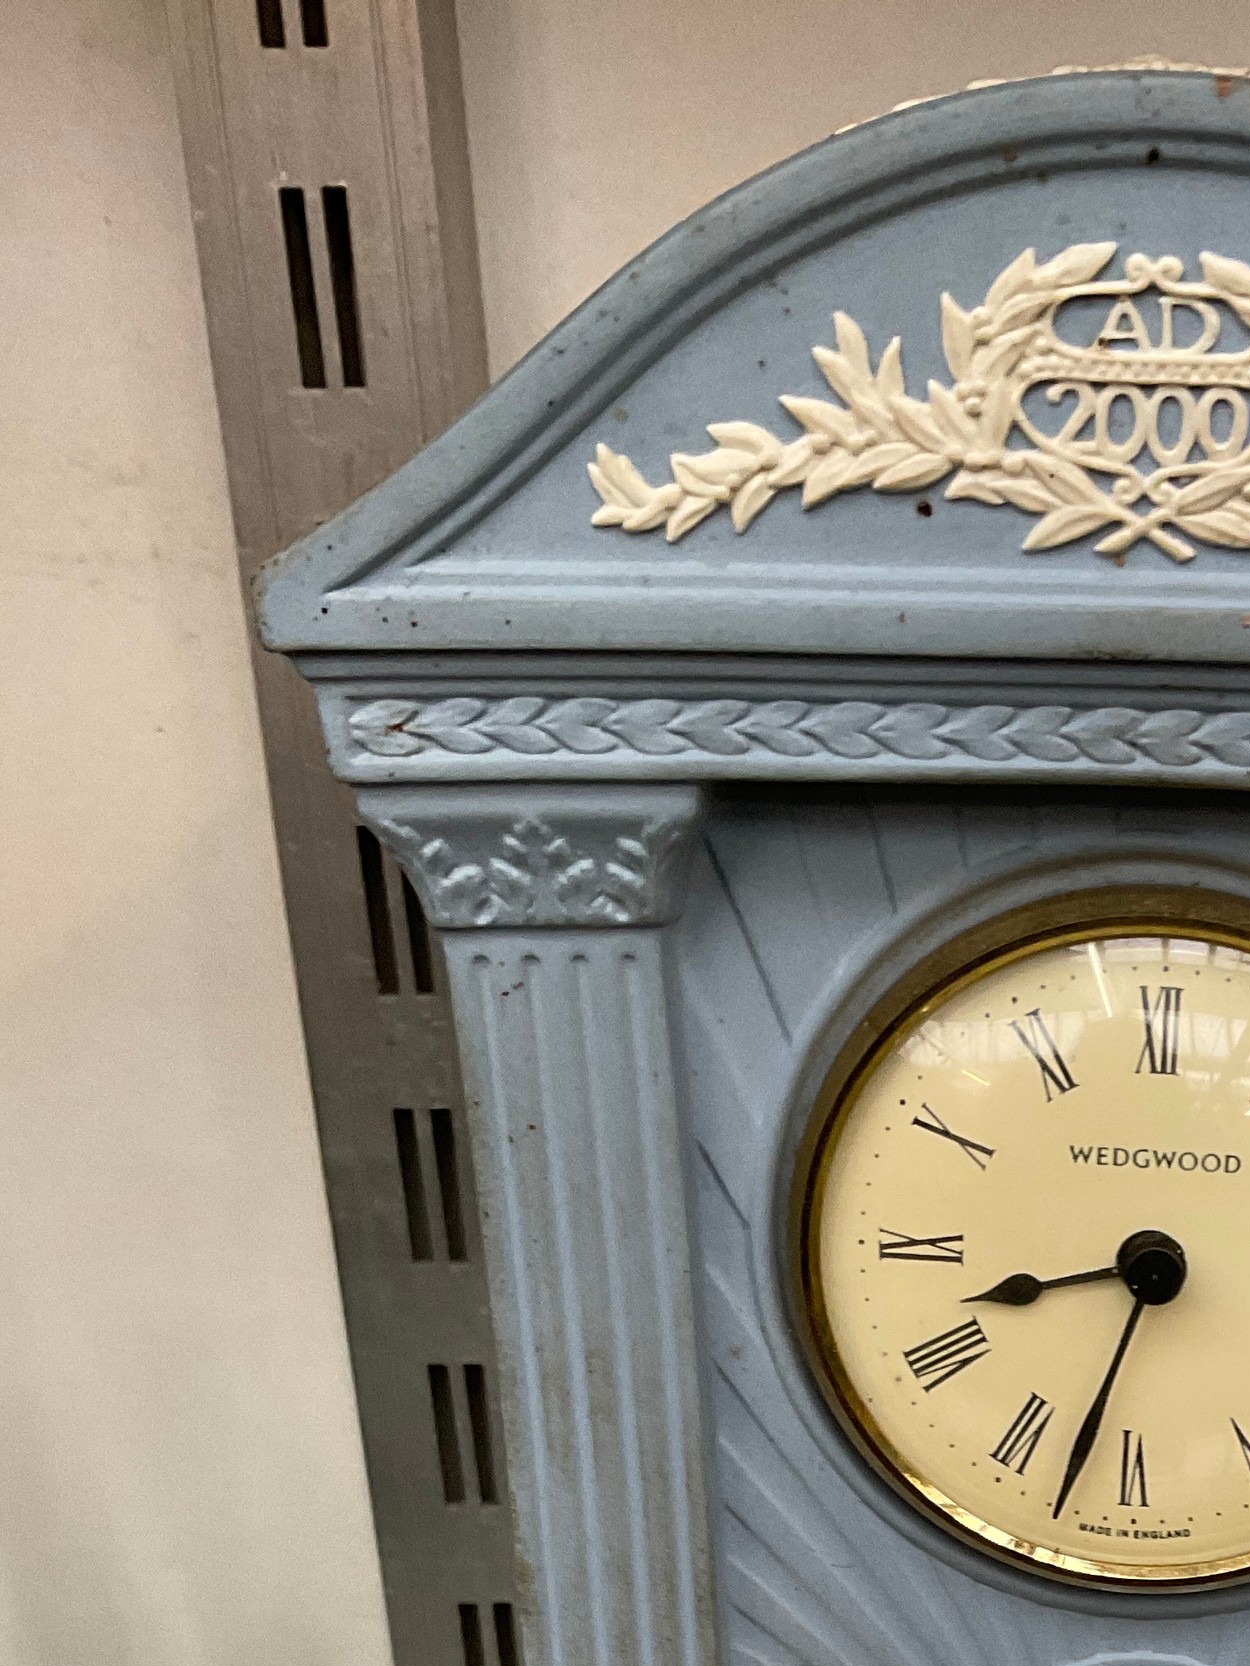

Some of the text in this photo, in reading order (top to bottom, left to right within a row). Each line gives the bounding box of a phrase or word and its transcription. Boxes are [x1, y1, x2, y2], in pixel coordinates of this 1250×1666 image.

[1045, 382, 1249, 466] 2000
[1009, 1008, 1080, 1103] XI
[1135, 985, 1185, 1076] XII
[911, 1102, 997, 1171] X
[1069, 1145, 1242, 1174] WEDGWOOD
[879, 1228, 964, 1266] IX
[902, 1315, 992, 1393] VIII
[989, 1391, 1056, 1476] VII
[1118, 1429, 1150, 1507] VI
[1079, 1522, 1191, 1539] MADE IN ENGLAND
